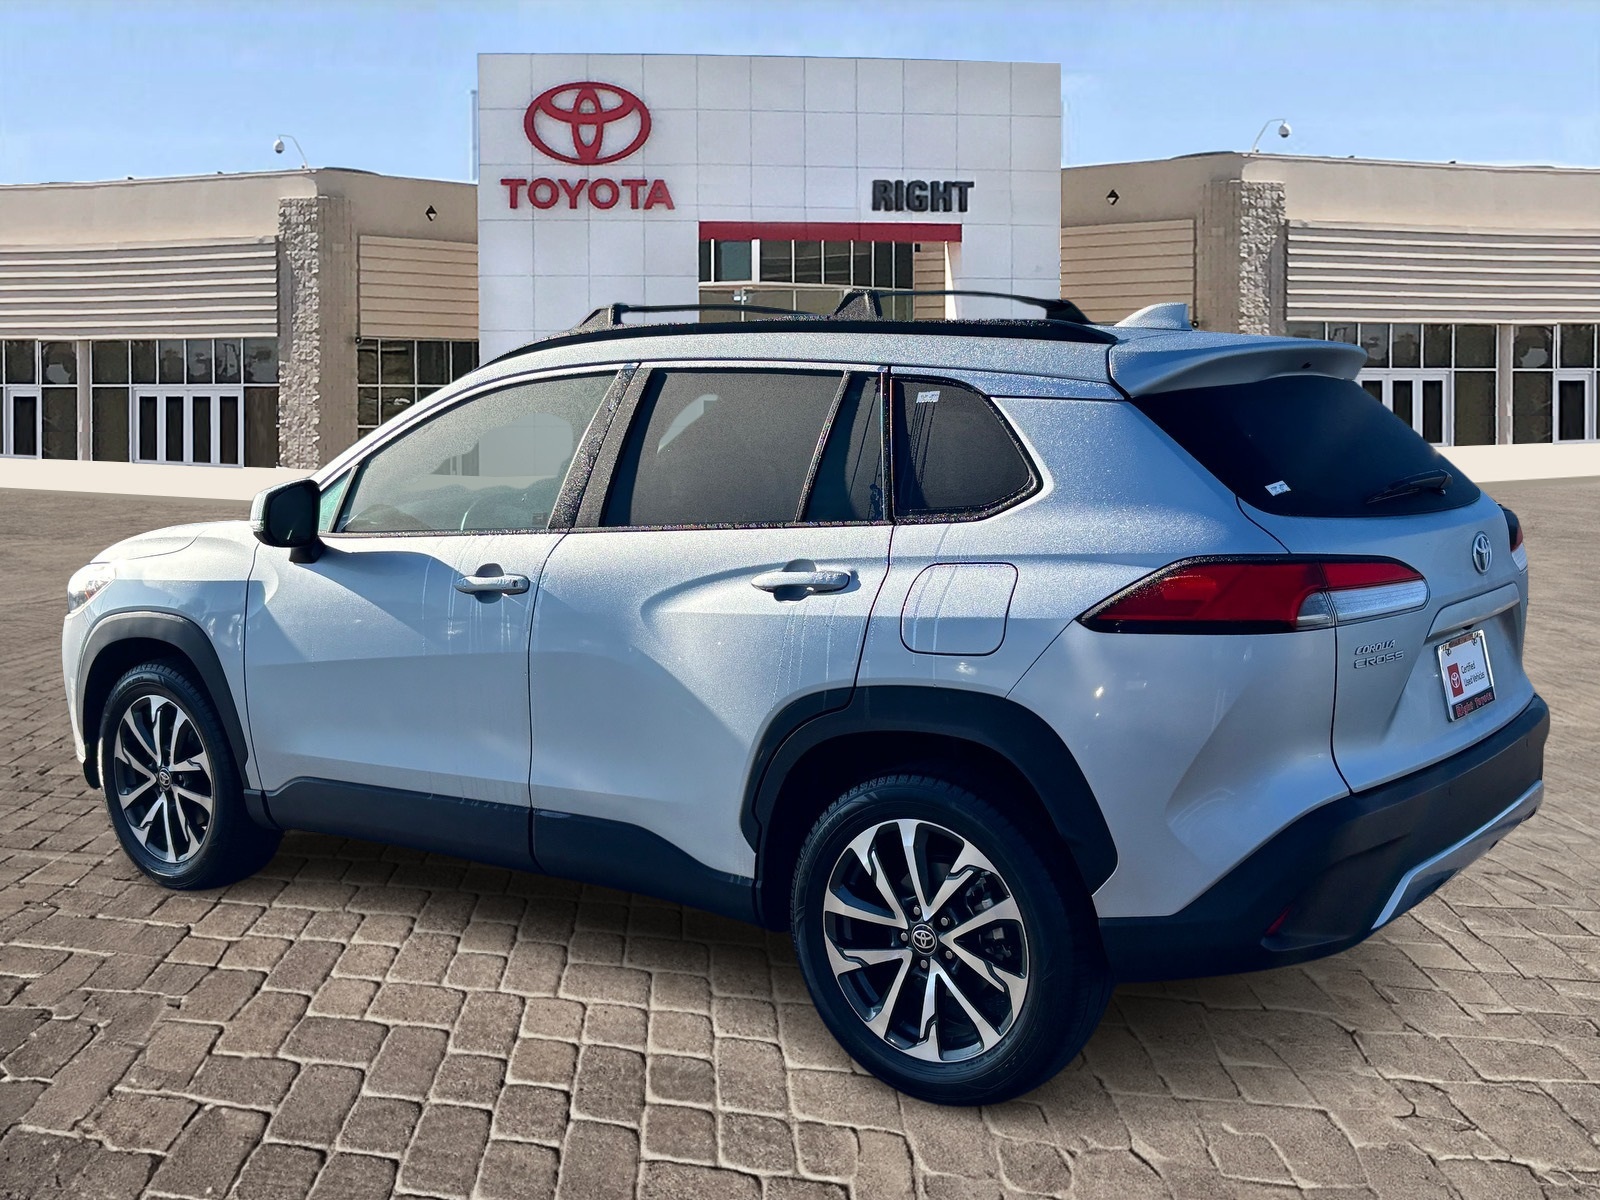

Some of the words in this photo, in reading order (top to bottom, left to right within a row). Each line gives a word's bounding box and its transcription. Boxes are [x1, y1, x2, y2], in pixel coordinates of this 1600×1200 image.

[501, 178, 675, 210] TOYOTA
[871, 179, 975, 213] RIGHT
[1355, 639, 1396, 655] COROLLA
[1354, 650, 1404, 669] CROSS
[1460, 660, 1476, 674] Certified
[1473, 671, 1486, 684] Vehicles
